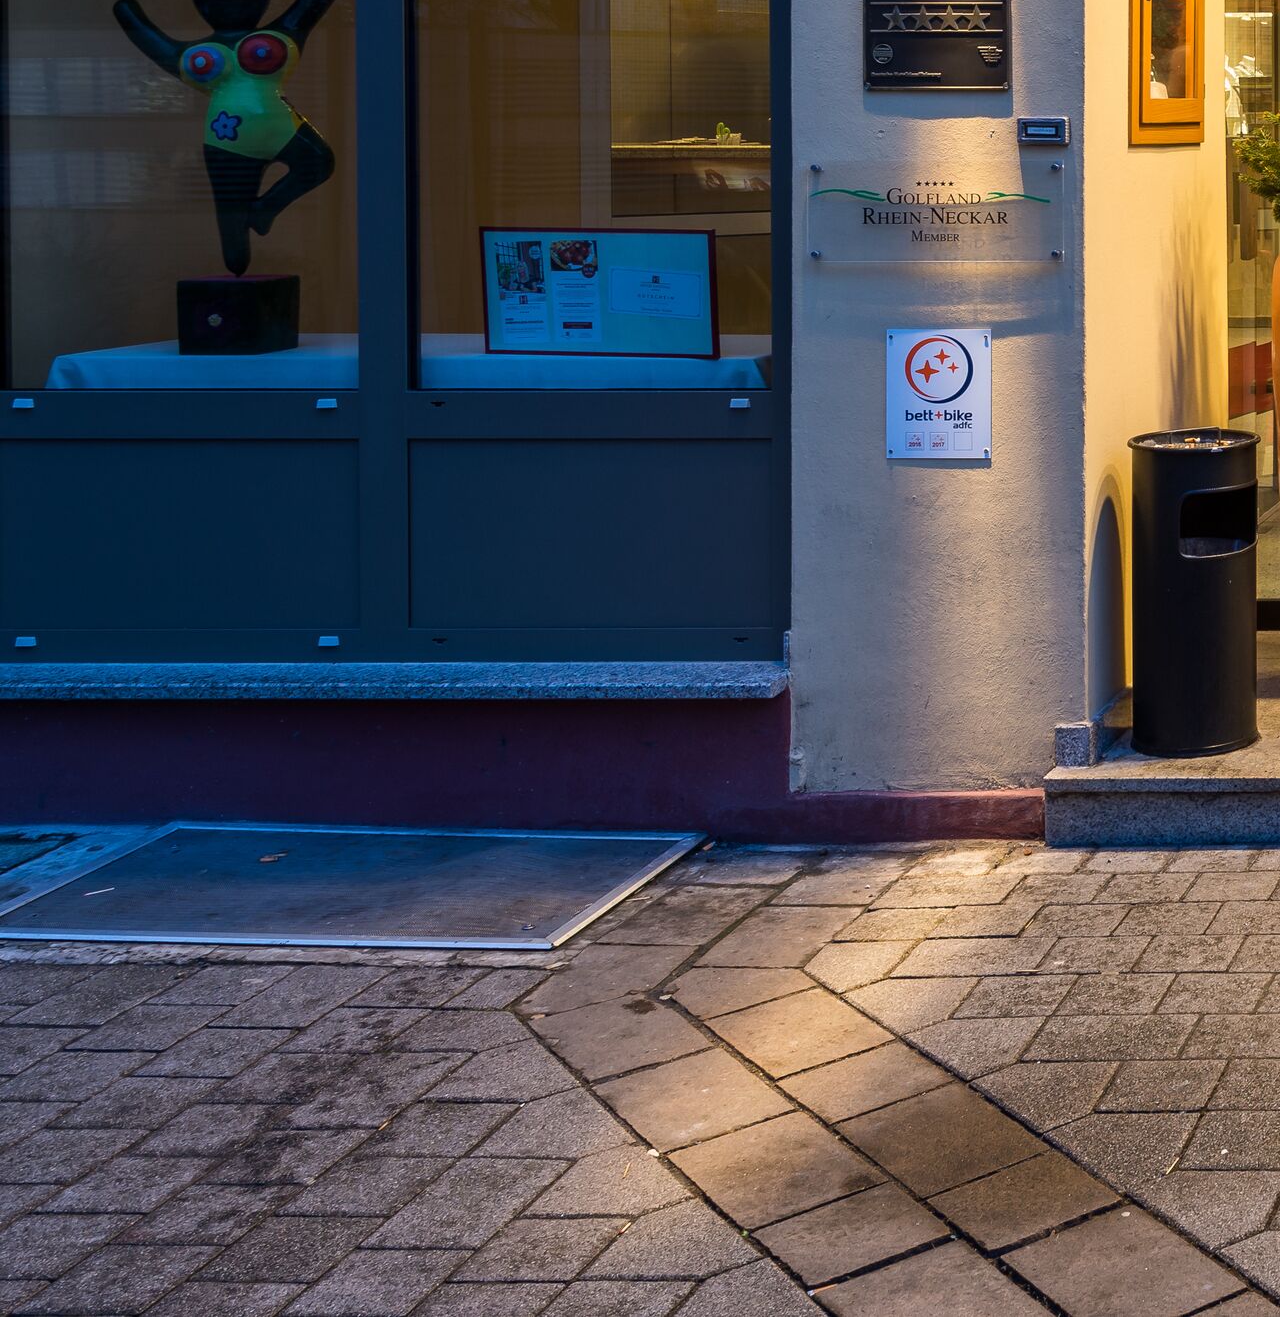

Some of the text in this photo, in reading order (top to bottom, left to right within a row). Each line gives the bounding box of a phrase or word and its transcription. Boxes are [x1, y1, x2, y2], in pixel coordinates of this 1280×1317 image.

[886, 188, 981, 205] GOLFLAND
[862, 207, 1009, 225] RHEIN-NECKAR
[911, 230, 960, 242] MEMBER
[905, 410, 973, 421] bett+bike
